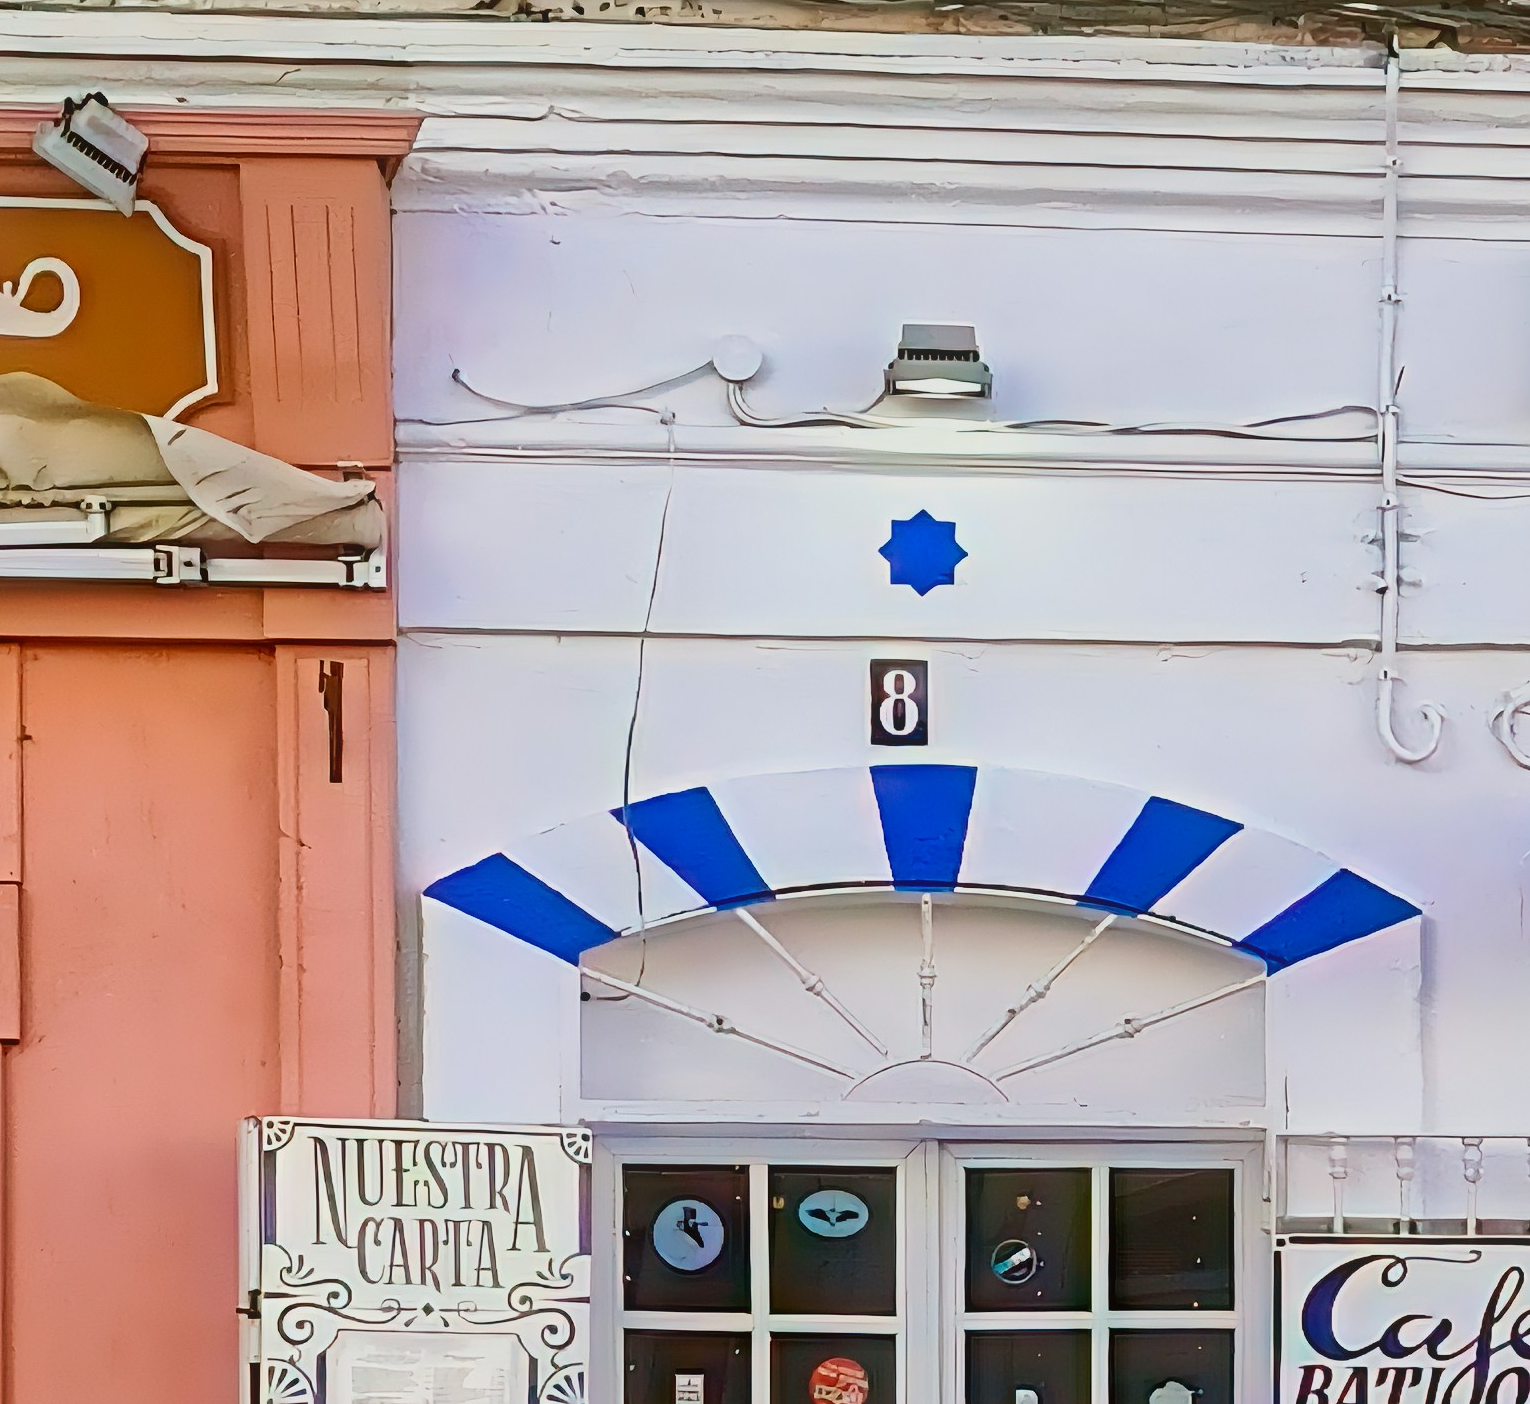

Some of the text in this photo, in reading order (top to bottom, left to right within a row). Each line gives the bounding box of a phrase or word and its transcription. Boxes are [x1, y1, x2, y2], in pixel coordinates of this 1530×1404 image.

[879, 669, 919, 736] 8
[307, 1136, 551, 1253] NUESTRA
[357, 1216, 506, 1295] CARTA
